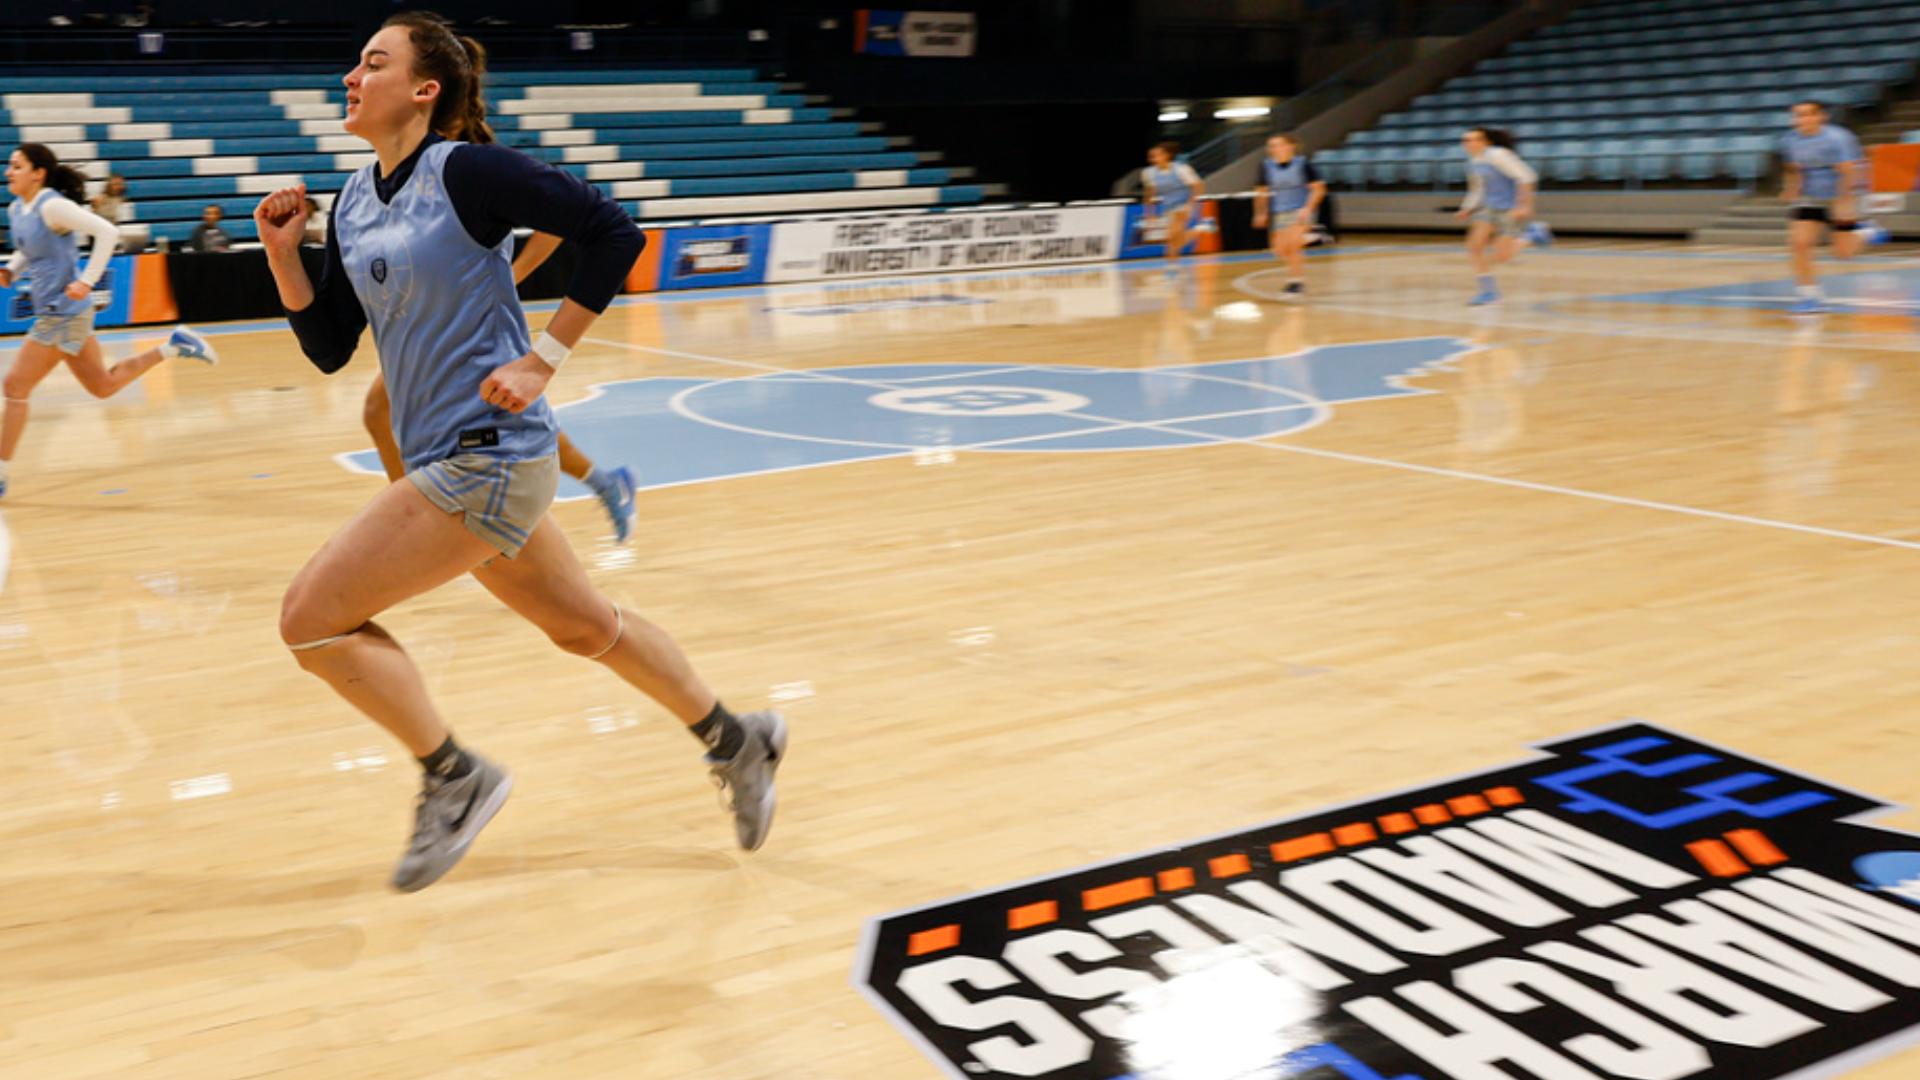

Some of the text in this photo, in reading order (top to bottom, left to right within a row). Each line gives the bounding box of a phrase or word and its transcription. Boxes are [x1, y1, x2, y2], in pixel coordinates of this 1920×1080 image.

[834, 222, 887, 247] FIRST
[905, 217, 974, 242] SECOND
[984, 213, 1059, 238] ROUNDS
[823, 235, 1109, 274] UNIVERSITY OF NORTH CAROLINA
[1340, 866, 1920, 1080] MARCH
